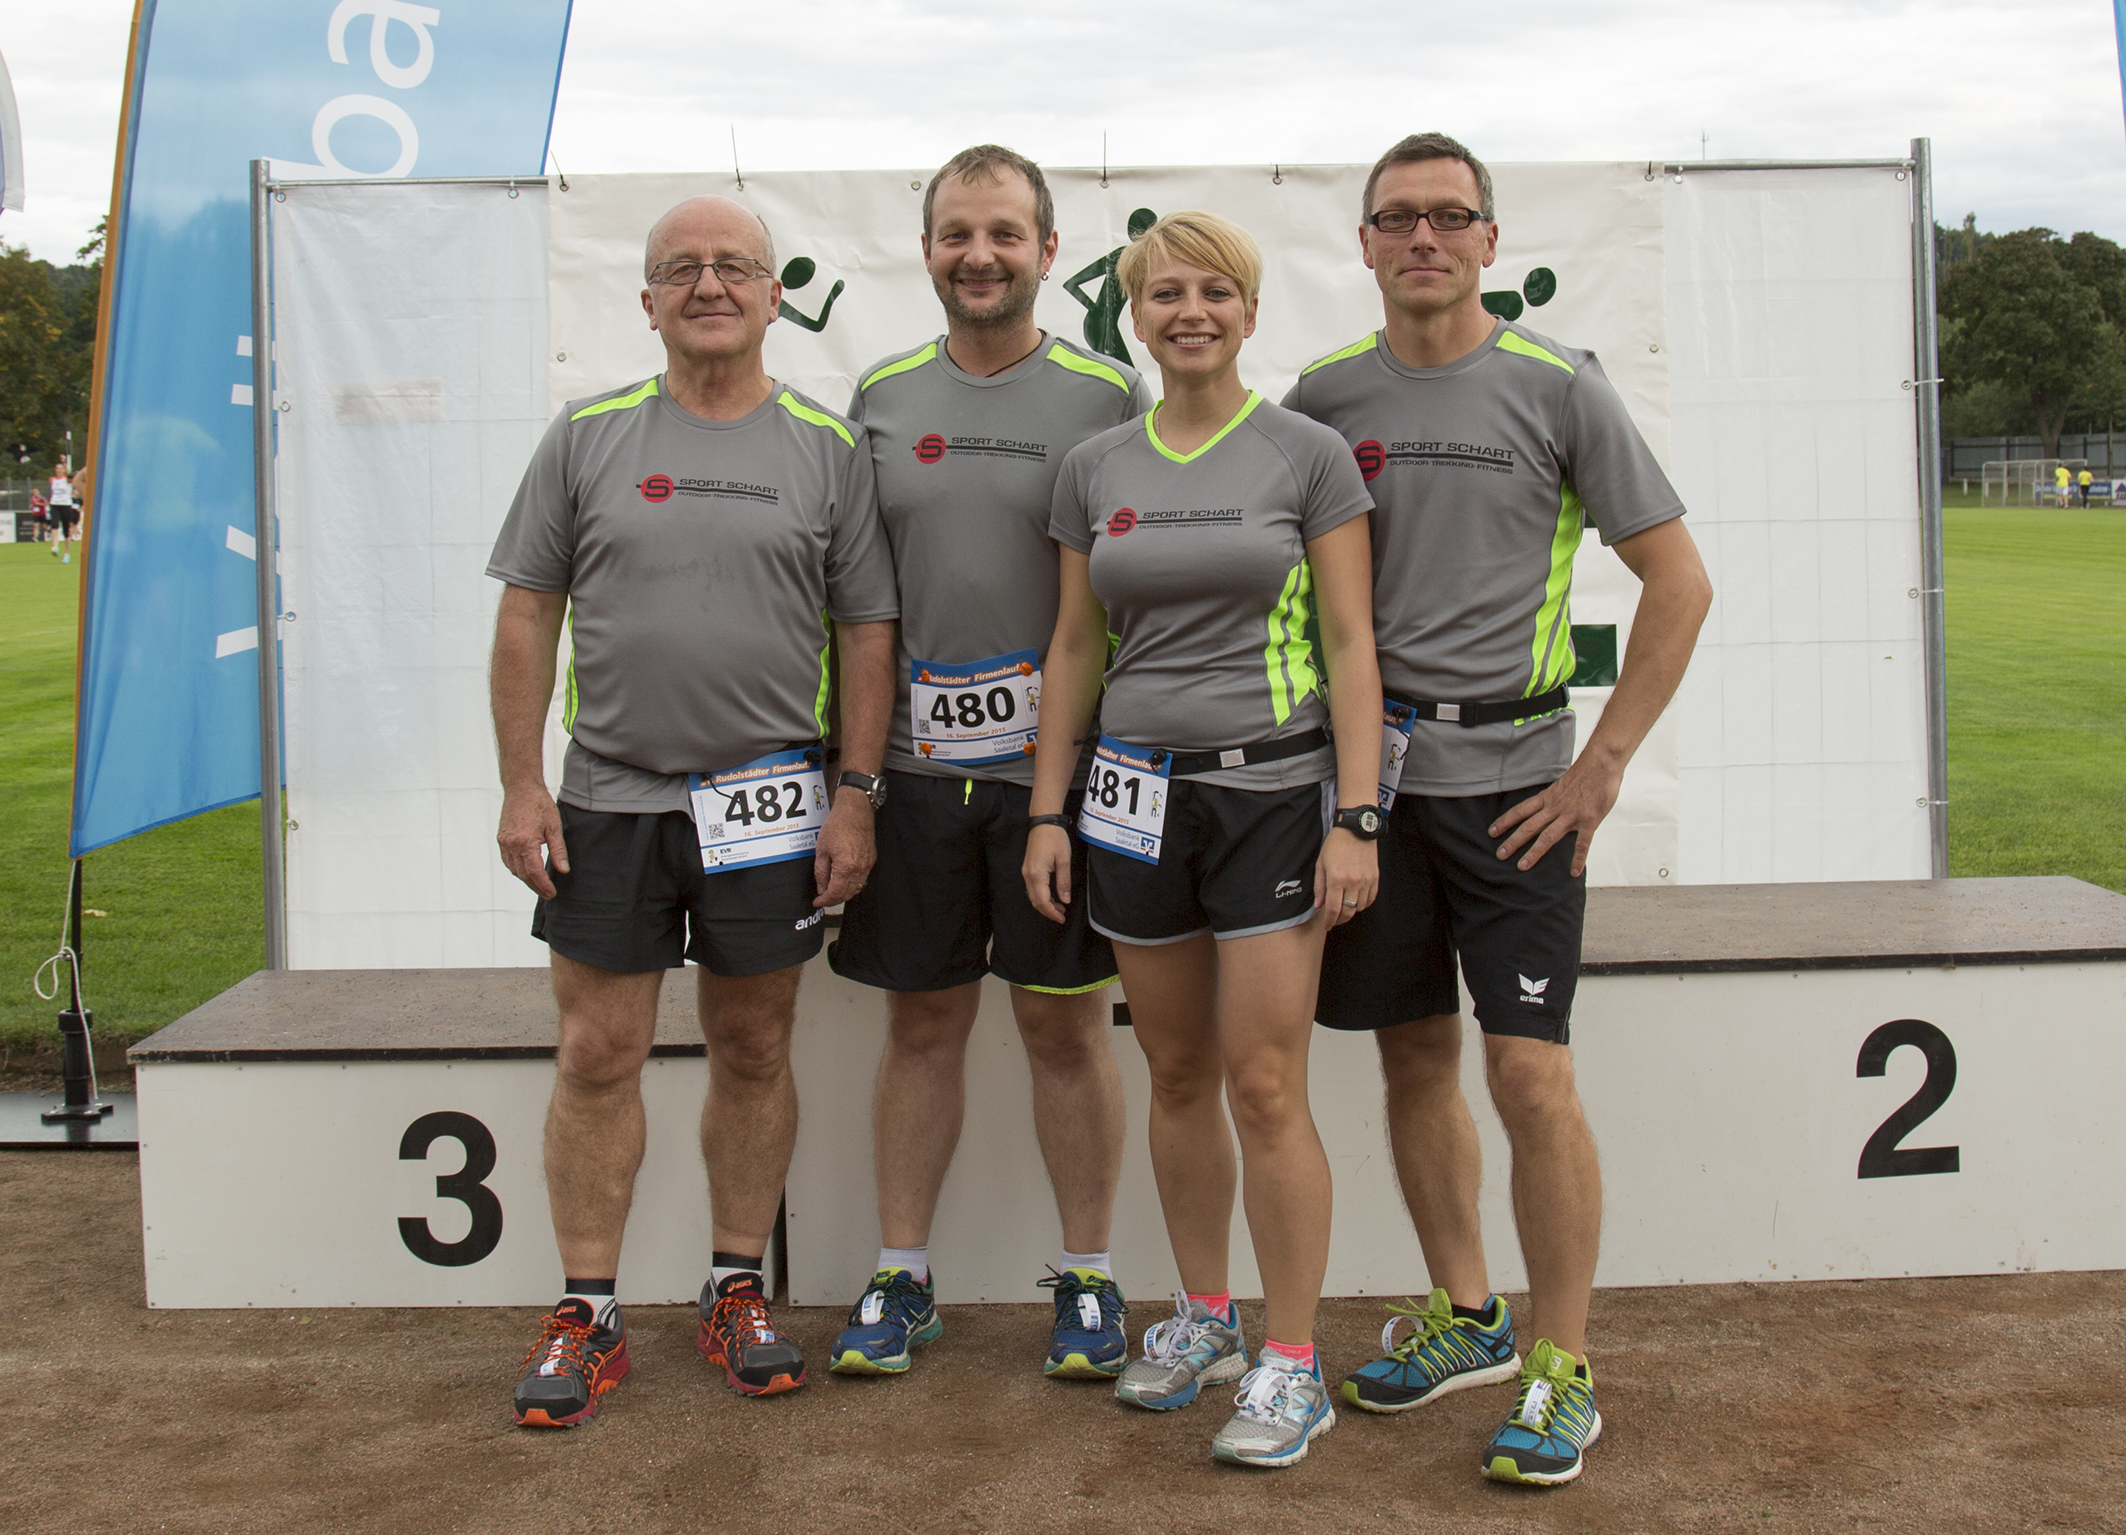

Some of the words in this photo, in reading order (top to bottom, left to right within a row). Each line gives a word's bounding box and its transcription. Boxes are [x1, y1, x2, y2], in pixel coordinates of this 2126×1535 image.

[951, 436, 993, 446] SPORT
[996, 439, 1047, 452] SCHART
[1391, 442, 1442, 451] SPORT
[1447, 442, 1515, 459] SCHART
[679, 478, 723, 488] SPORT
[726, 481, 779, 495] SCHART
[1143, 511, 1185, 519] SPORT
[1189, 509, 1244, 518] SCHART
[930, 686, 1015, 728] 480
[956, 730, 989, 740] September
[991, 727, 1006, 735] 2015
[992, 735, 1024, 746] Volksbank
[993, 743, 1016, 754] Saaletal
[716, 767, 770, 783] Rudolstädter
[1088, 764, 1141, 815] 481
[725, 781, 808, 826] 482
[755, 825, 785, 837] September
[787, 823, 800, 831] 2015
[1115, 828, 1140, 841] Volksbank
[1519, 994, 1545, 1005] erima
[1856, 1018, 1960, 1180] 2
[397, 1110, 504, 1268] 3
